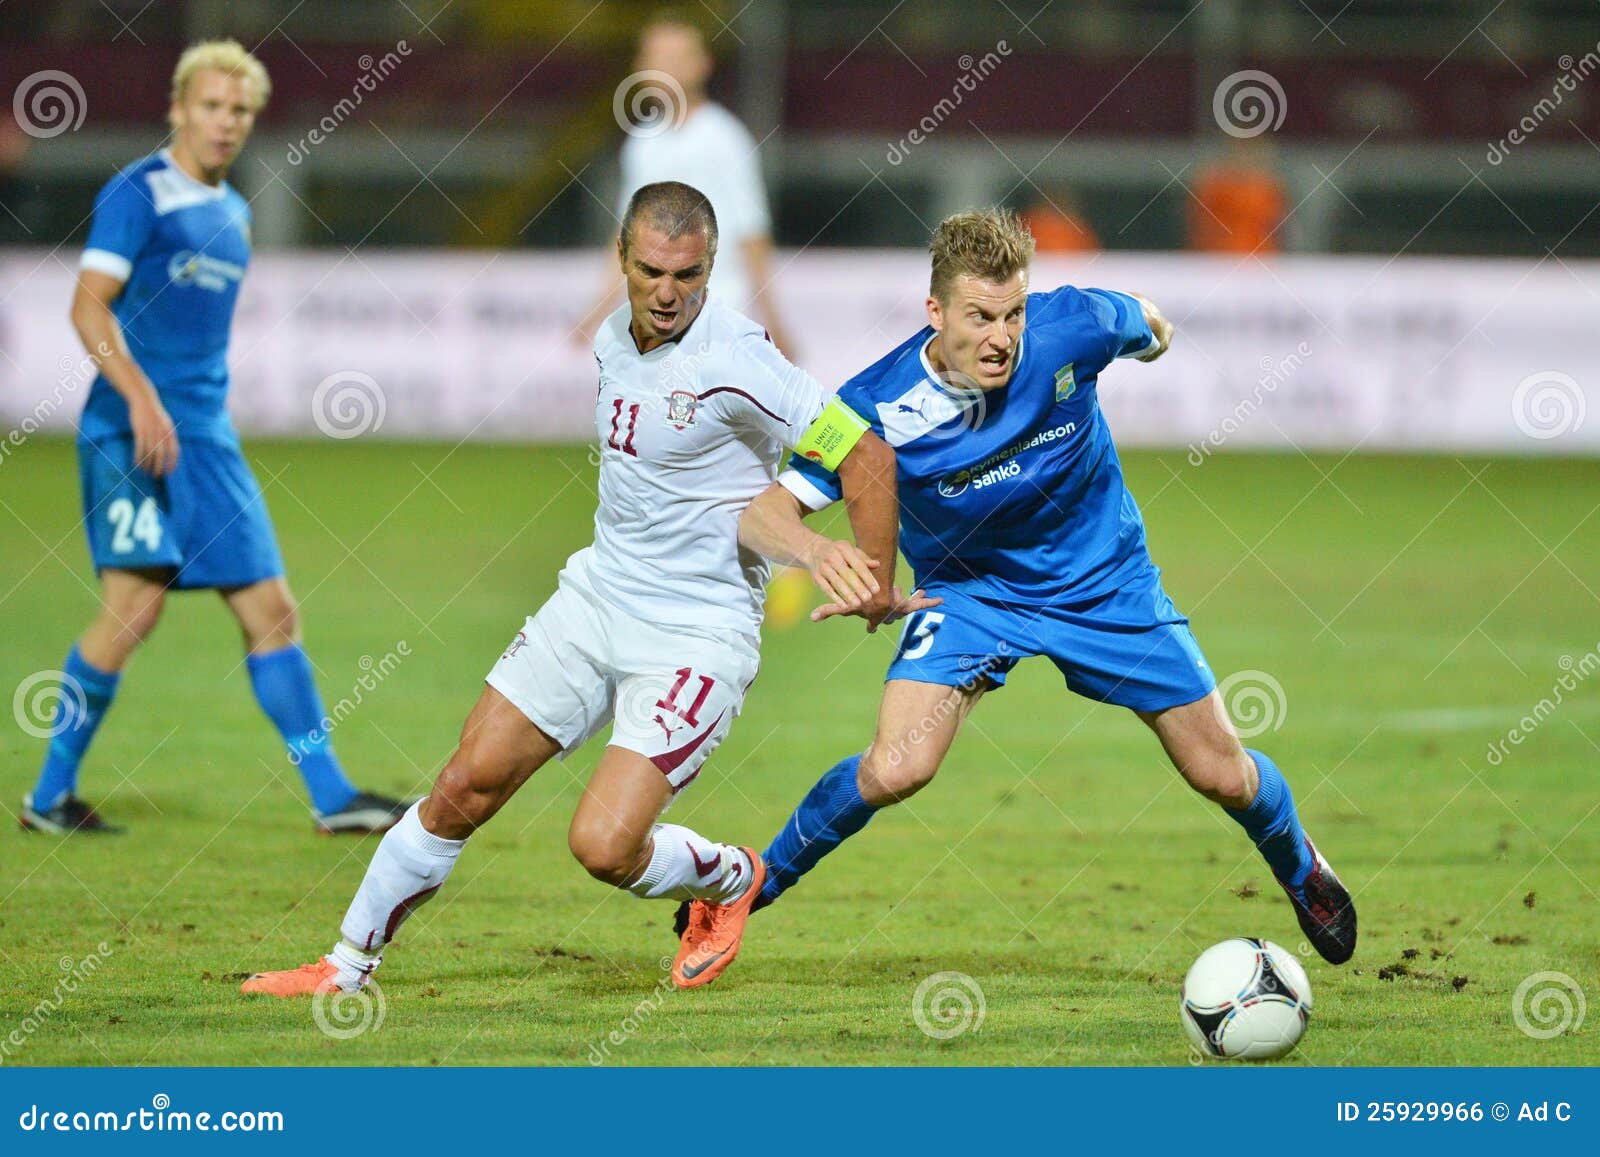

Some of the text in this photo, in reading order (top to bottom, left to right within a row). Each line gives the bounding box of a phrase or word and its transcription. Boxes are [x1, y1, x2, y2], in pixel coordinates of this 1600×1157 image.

[607, 398, 640, 457] 11
[814, 424, 833, 445] UNITE
[107, 497, 164, 554] 24
[655, 667, 716, 729] 11
